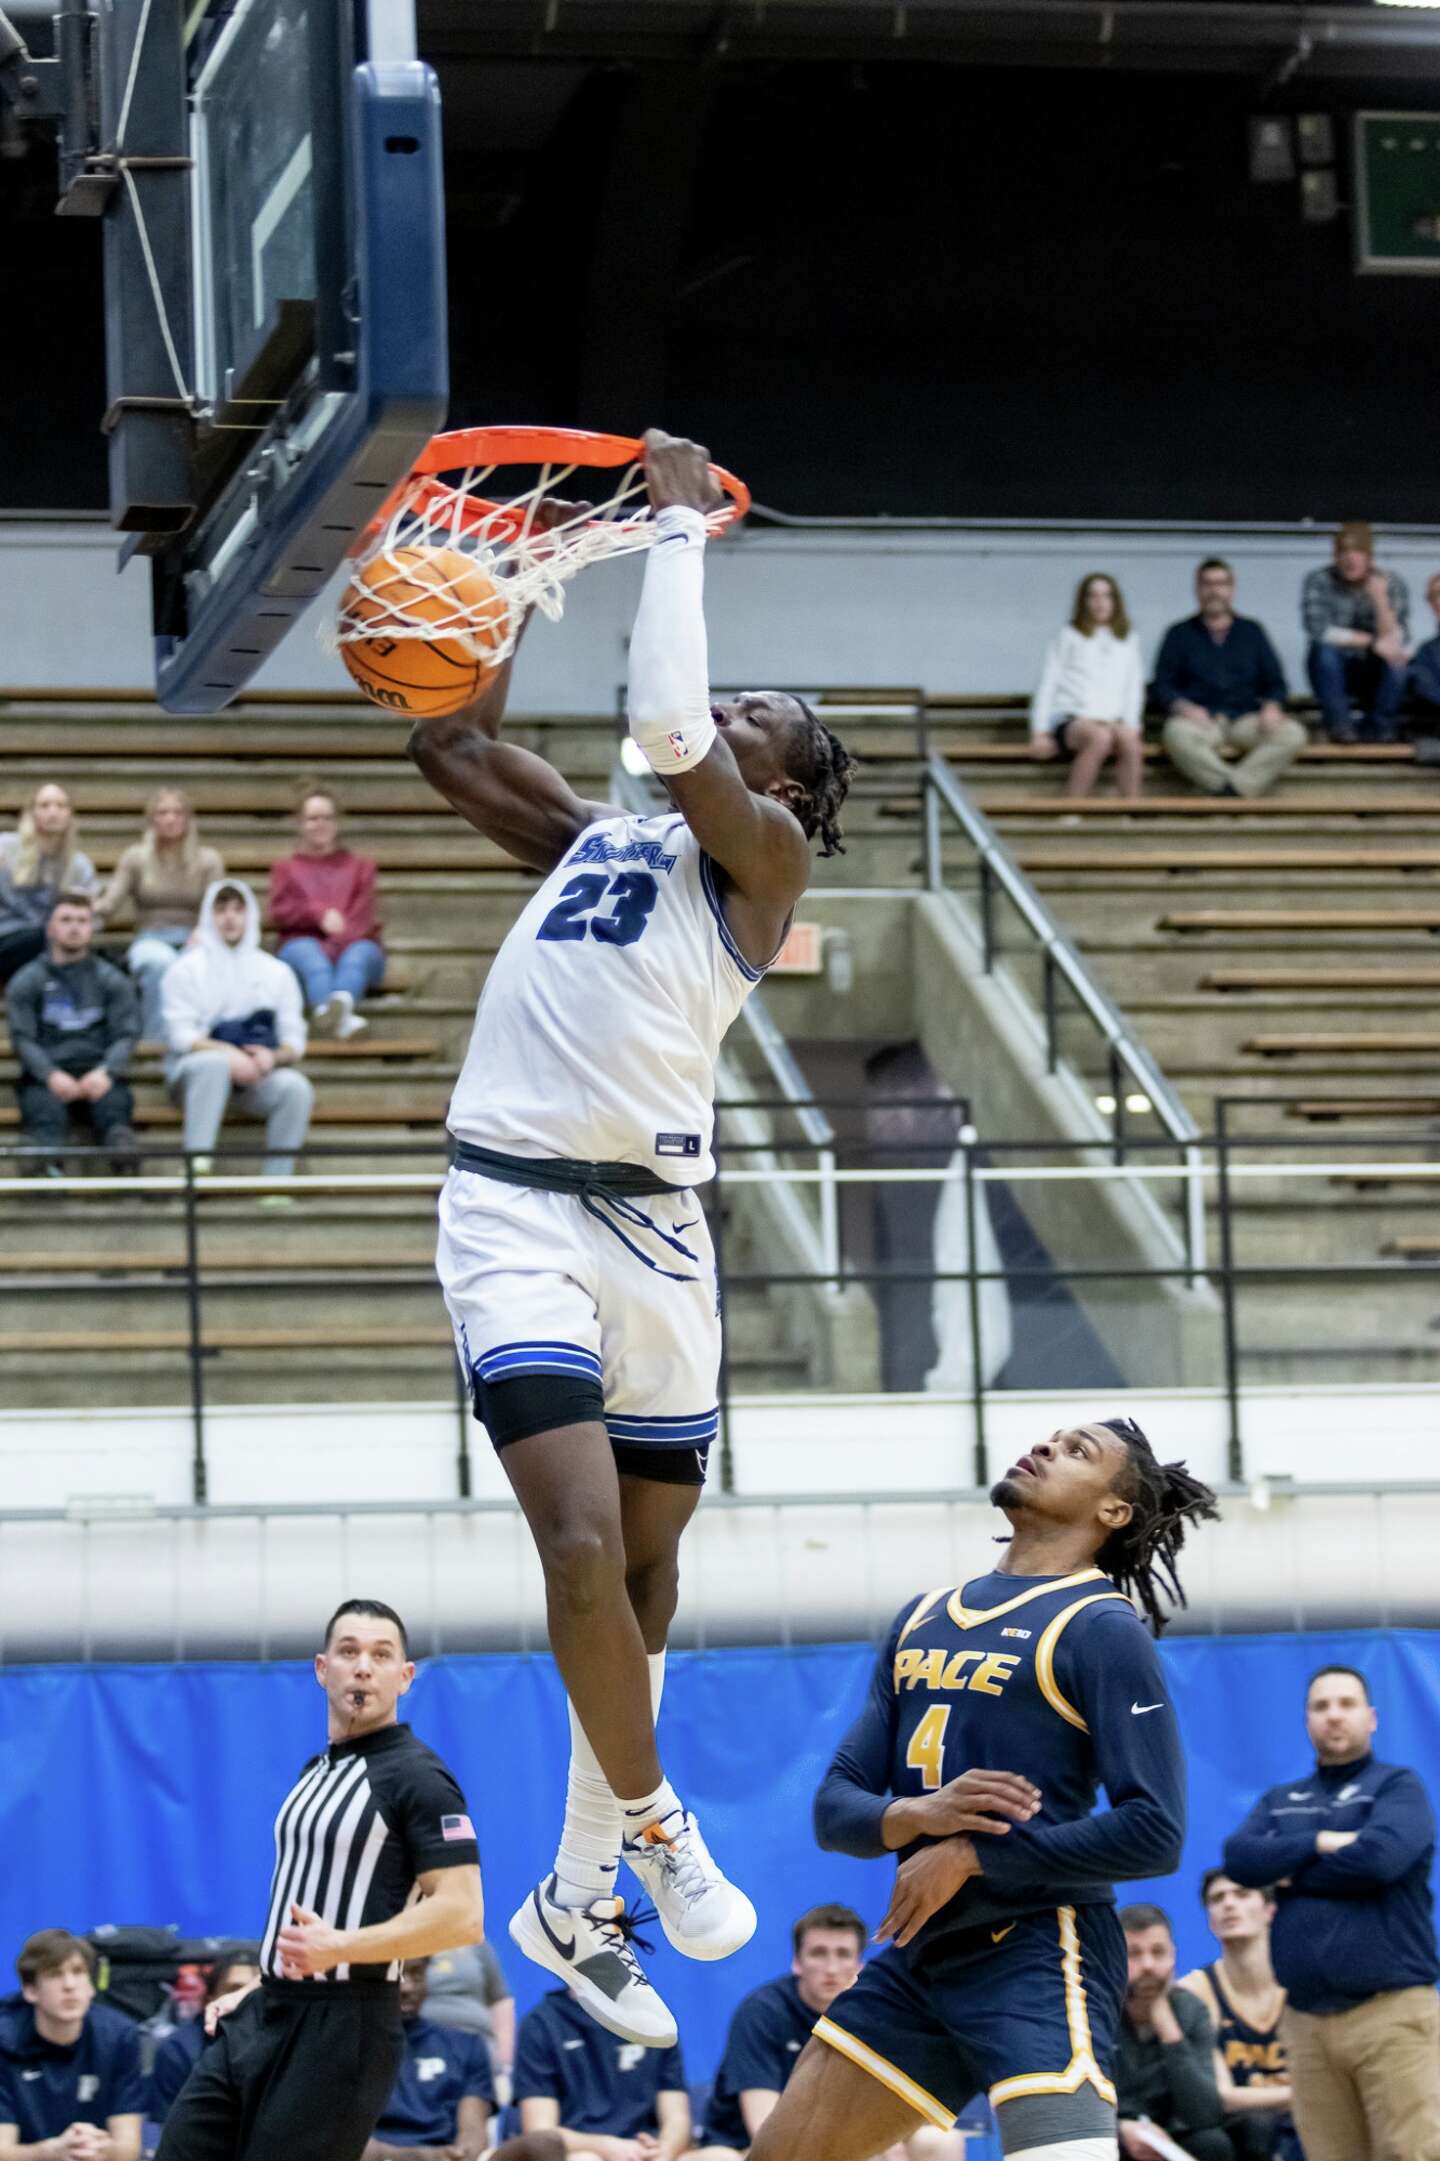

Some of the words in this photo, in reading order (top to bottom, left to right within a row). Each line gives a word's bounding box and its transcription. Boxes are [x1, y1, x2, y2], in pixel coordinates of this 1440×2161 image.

[536, 872, 659, 947] 23
[689, 1140, 696, 1151] L
[894, 1648, 1022, 1696] PACE
[906, 1704, 952, 1790] 4
[415, 2057, 447, 2081] P
[616, 2044, 646, 2070] P
[1226, 2040, 1287, 2070] PAC
